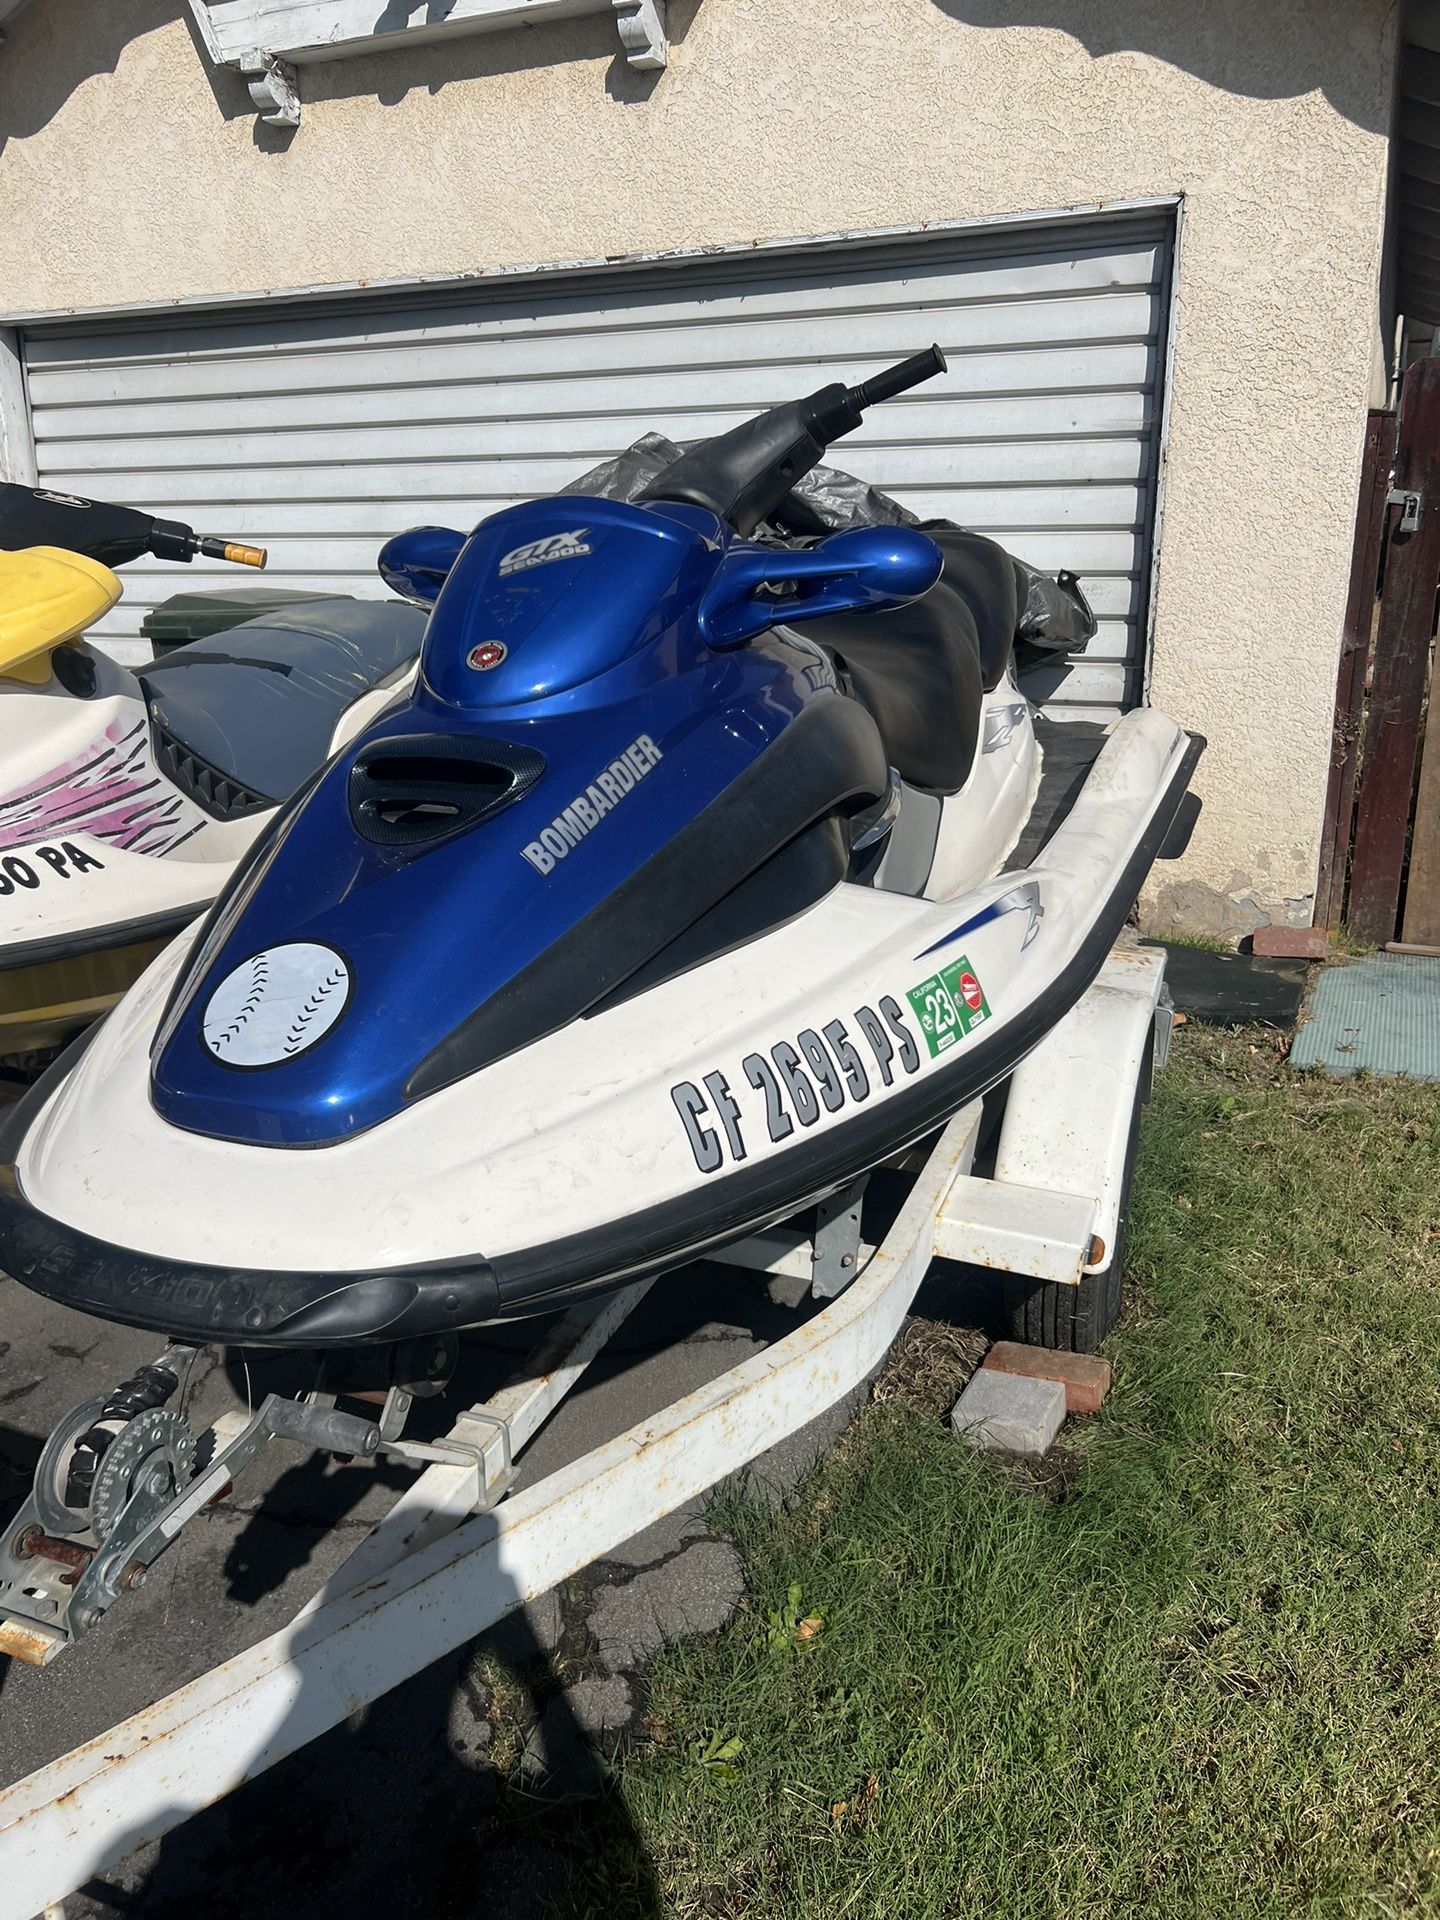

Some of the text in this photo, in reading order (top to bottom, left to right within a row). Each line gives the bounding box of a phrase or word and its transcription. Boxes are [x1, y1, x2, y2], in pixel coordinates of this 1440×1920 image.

[499, 528, 590, 567] GTX
[521, 733, 663, 876] BOMBARDIER
[35, 841, 105, 879] PA
[912, 980, 938, 999] CALIFORNIA
[925, 988, 956, 1035] 23
[670, 995, 921, 1174] CF 2695 PS
